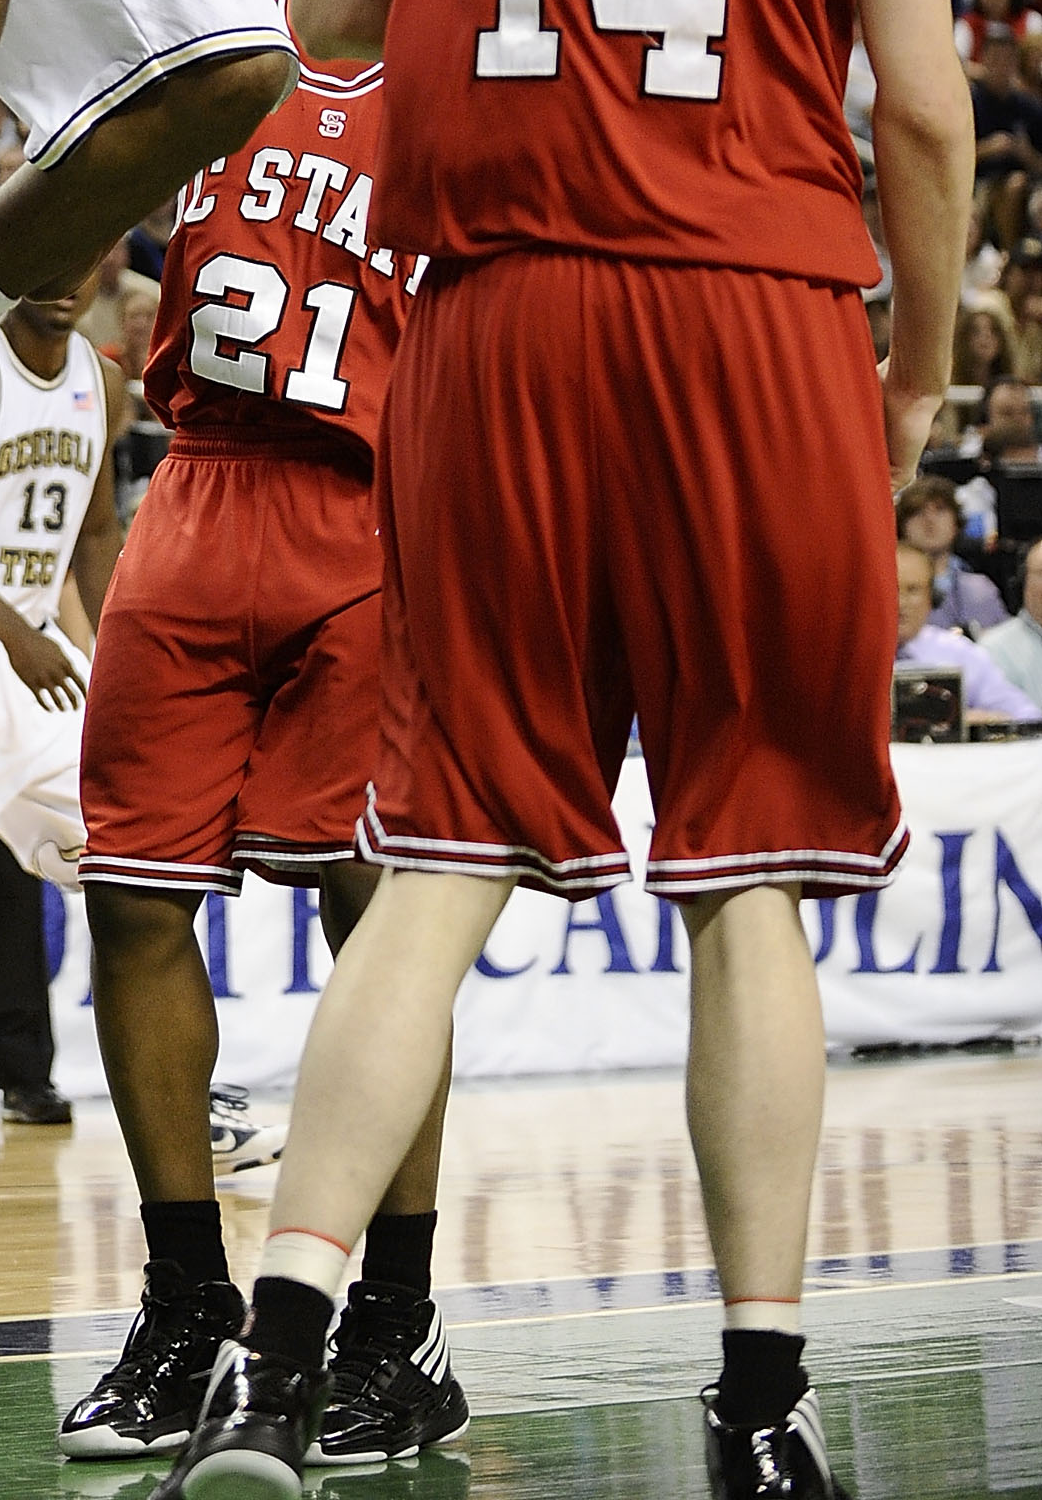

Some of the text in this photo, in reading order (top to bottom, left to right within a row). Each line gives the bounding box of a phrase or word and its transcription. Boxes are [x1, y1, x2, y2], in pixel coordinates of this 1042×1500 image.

[239, 147, 431, 297] STA
[190, 252, 357, 410] 21
[18, 481, 68, 533] 13
[0, 547, 57, 587] TEC
